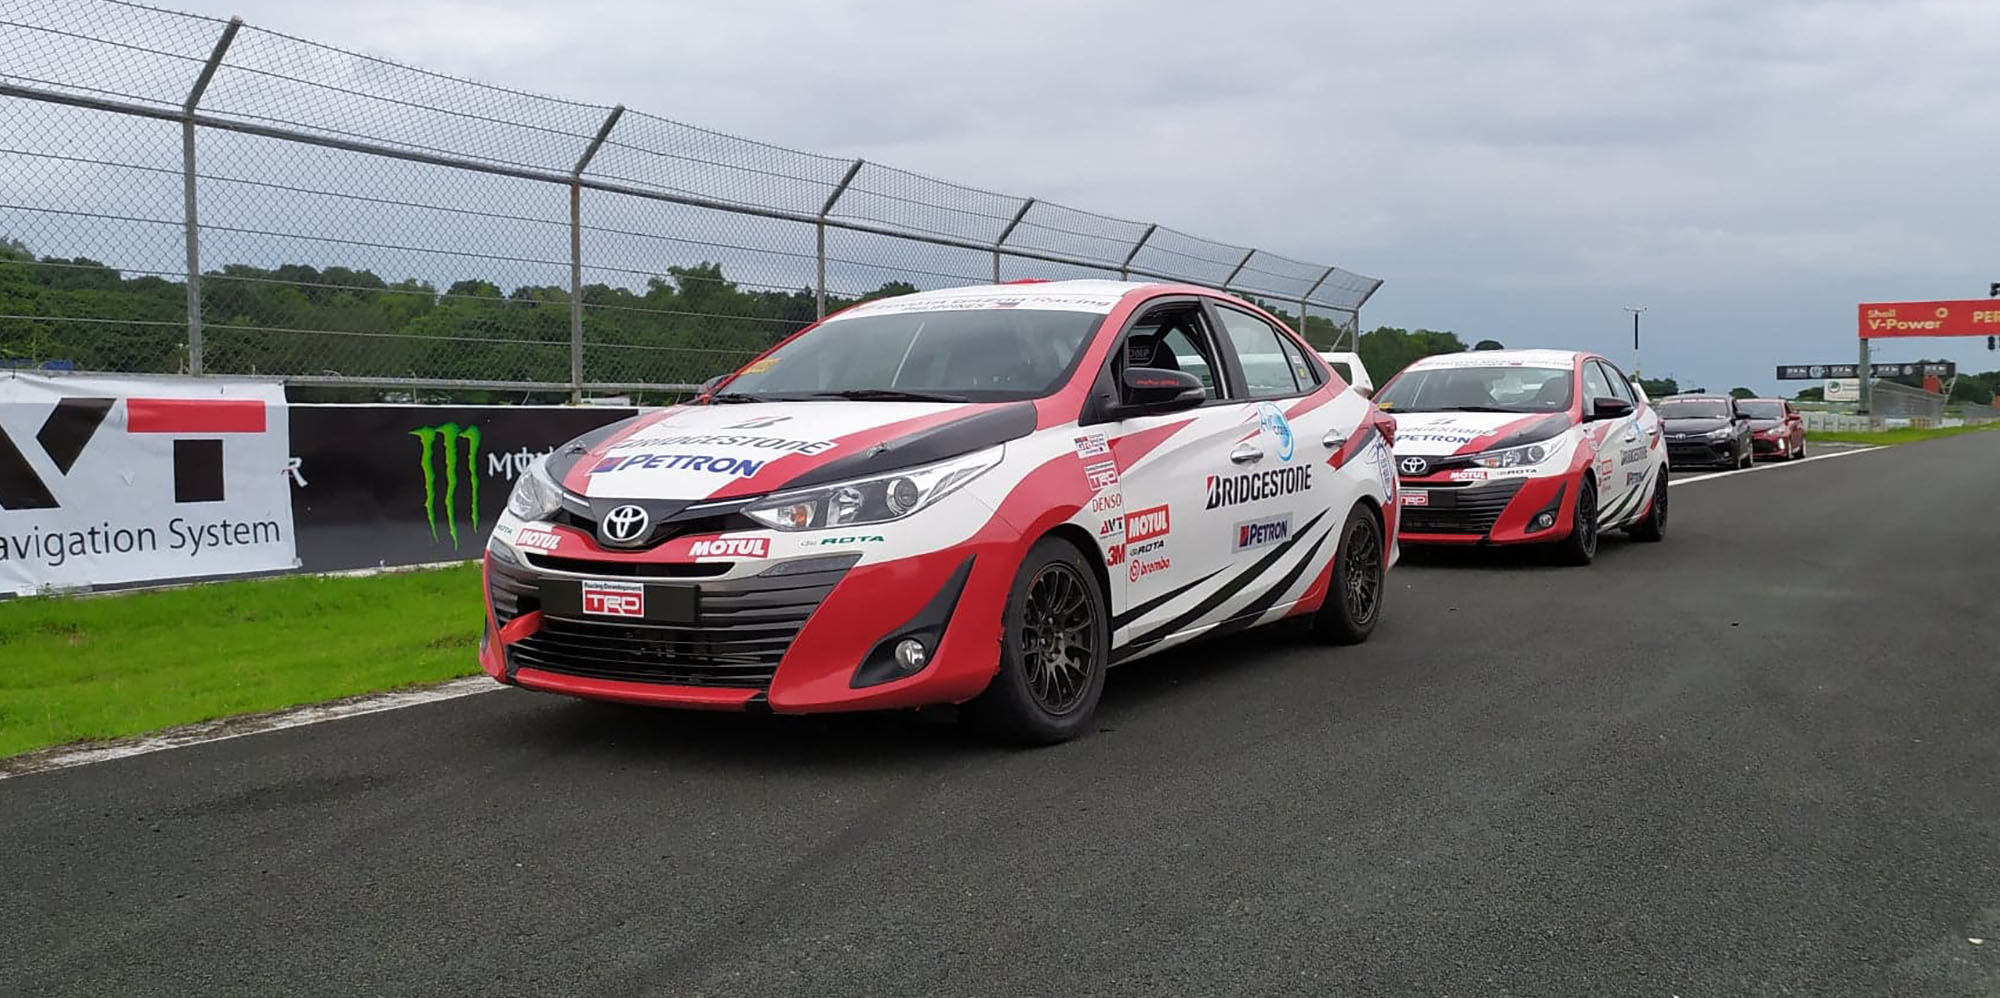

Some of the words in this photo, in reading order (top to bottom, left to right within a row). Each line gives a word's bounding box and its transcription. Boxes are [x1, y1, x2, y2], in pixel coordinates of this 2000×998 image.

[1868, 309, 1896, 318] Shell
[1868, 319, 1943, 330] V-Power
[618, 454, 765, 477] PETRON
[1450, 471, 1485, 480] MOTUL
[1206, 464, 1312, 510] BRIDGESTONE
[1092, 493, 1122, 513] DENSO
[1100, 516, 1123, 535] AVT
[1128, 509, 1168, 539] MOTUL
[1249, 520, 1288, 546] PETRON
[169, 517, 280, 557] System
[517, 529, 562, 550] MOTUL
[820, 535, 885, 546] ROTA
[1138, 540, 1164, 554] ROTA
[688, 538, 766, 557] MOTUL
[1107, 543, 1126, 567] 3M
[1141, 556, 1170, 576] brembo
[586, 594, 640, 615] TRD
